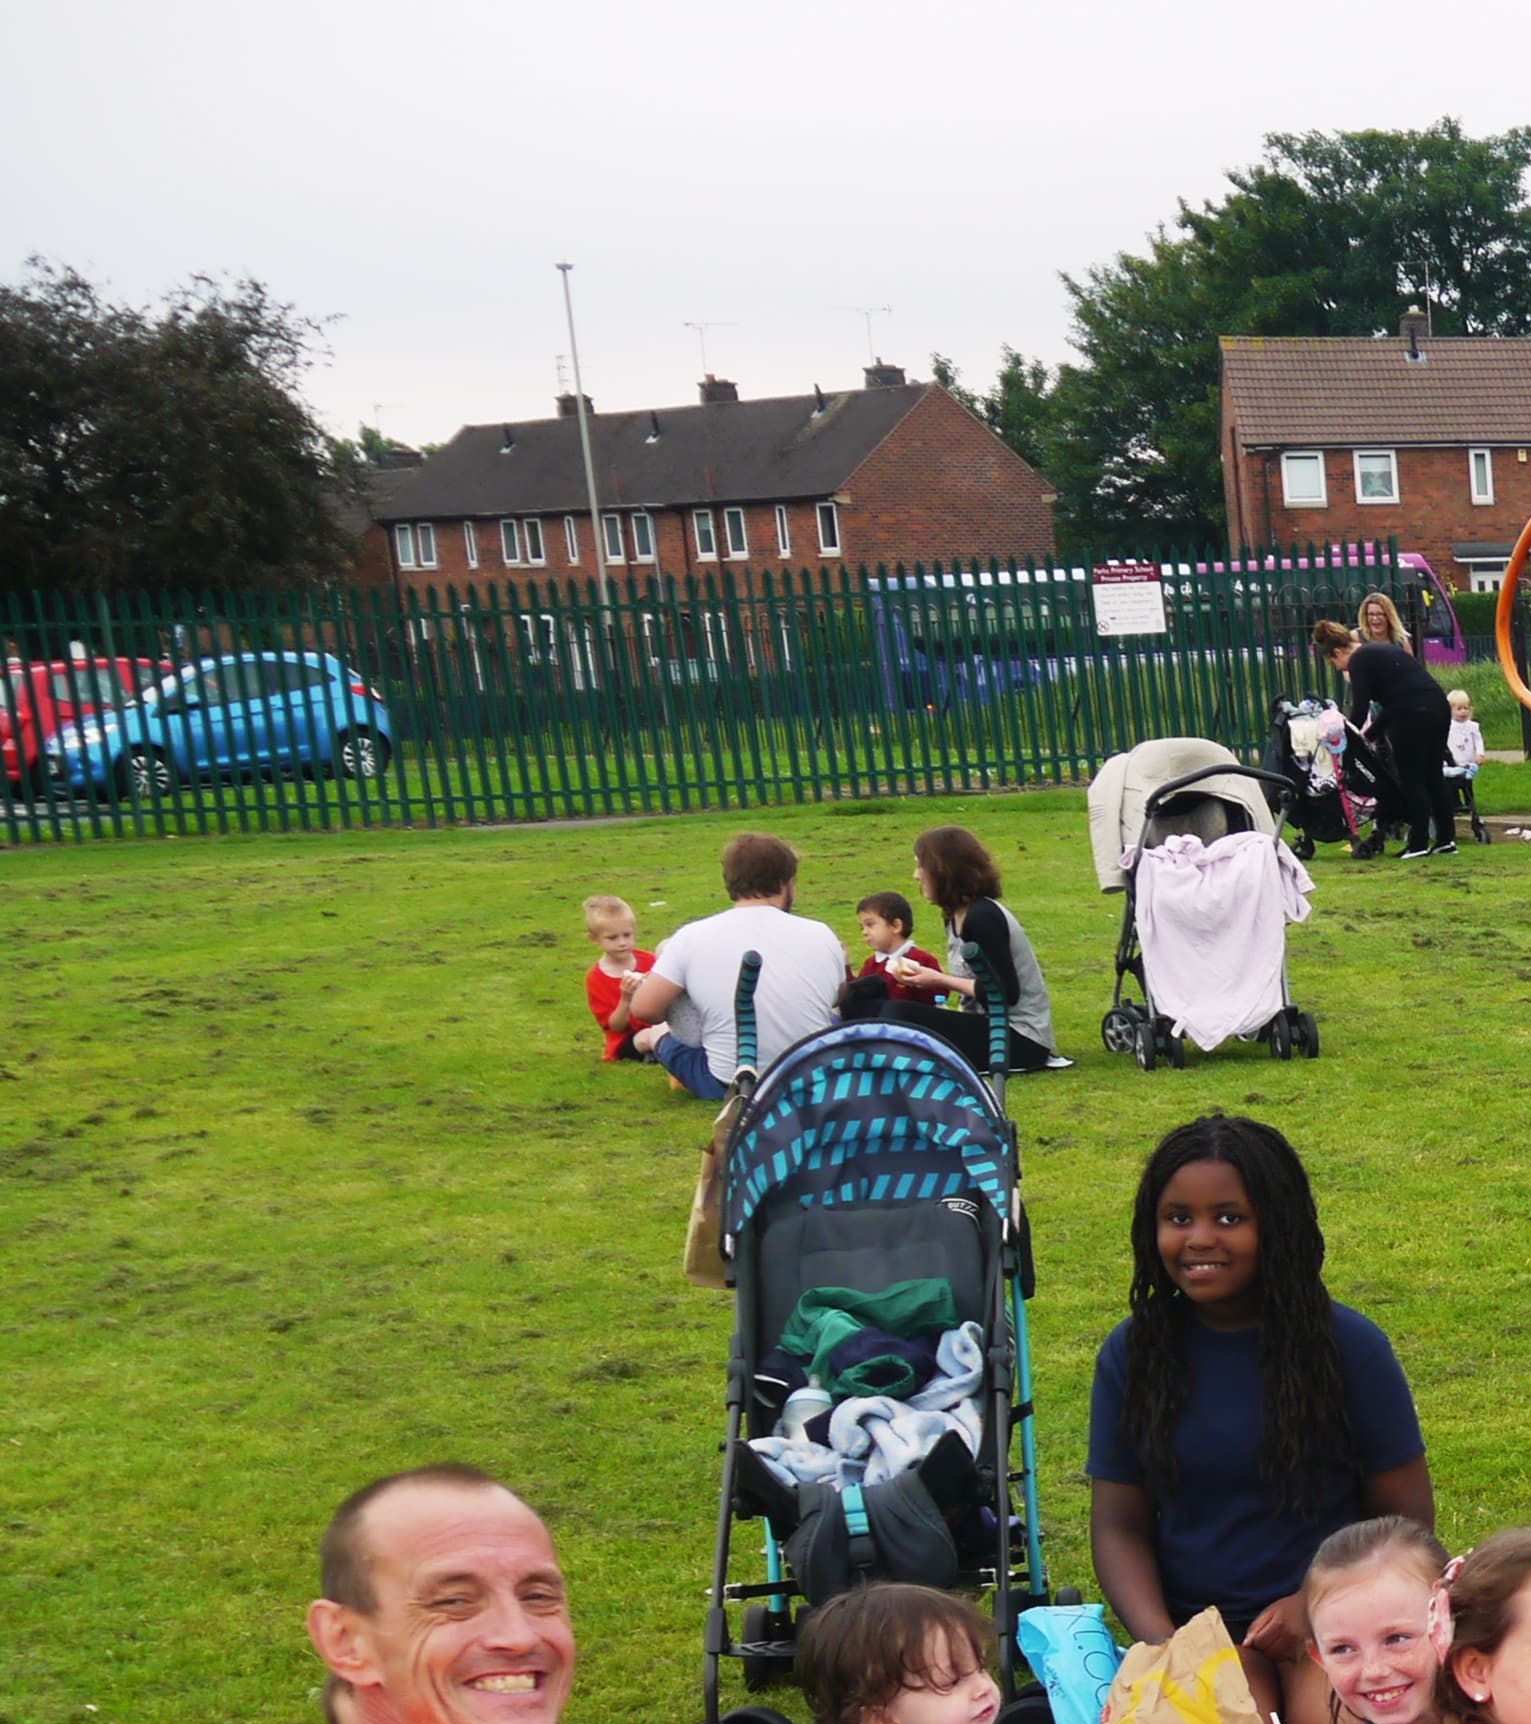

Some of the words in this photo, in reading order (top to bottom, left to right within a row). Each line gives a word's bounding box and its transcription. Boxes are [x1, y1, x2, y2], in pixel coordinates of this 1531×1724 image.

[1111, 566, 1134, 575] Primary
[1134, 565, 1154, 574] School
[1122, 574, 1148, 582] Property
